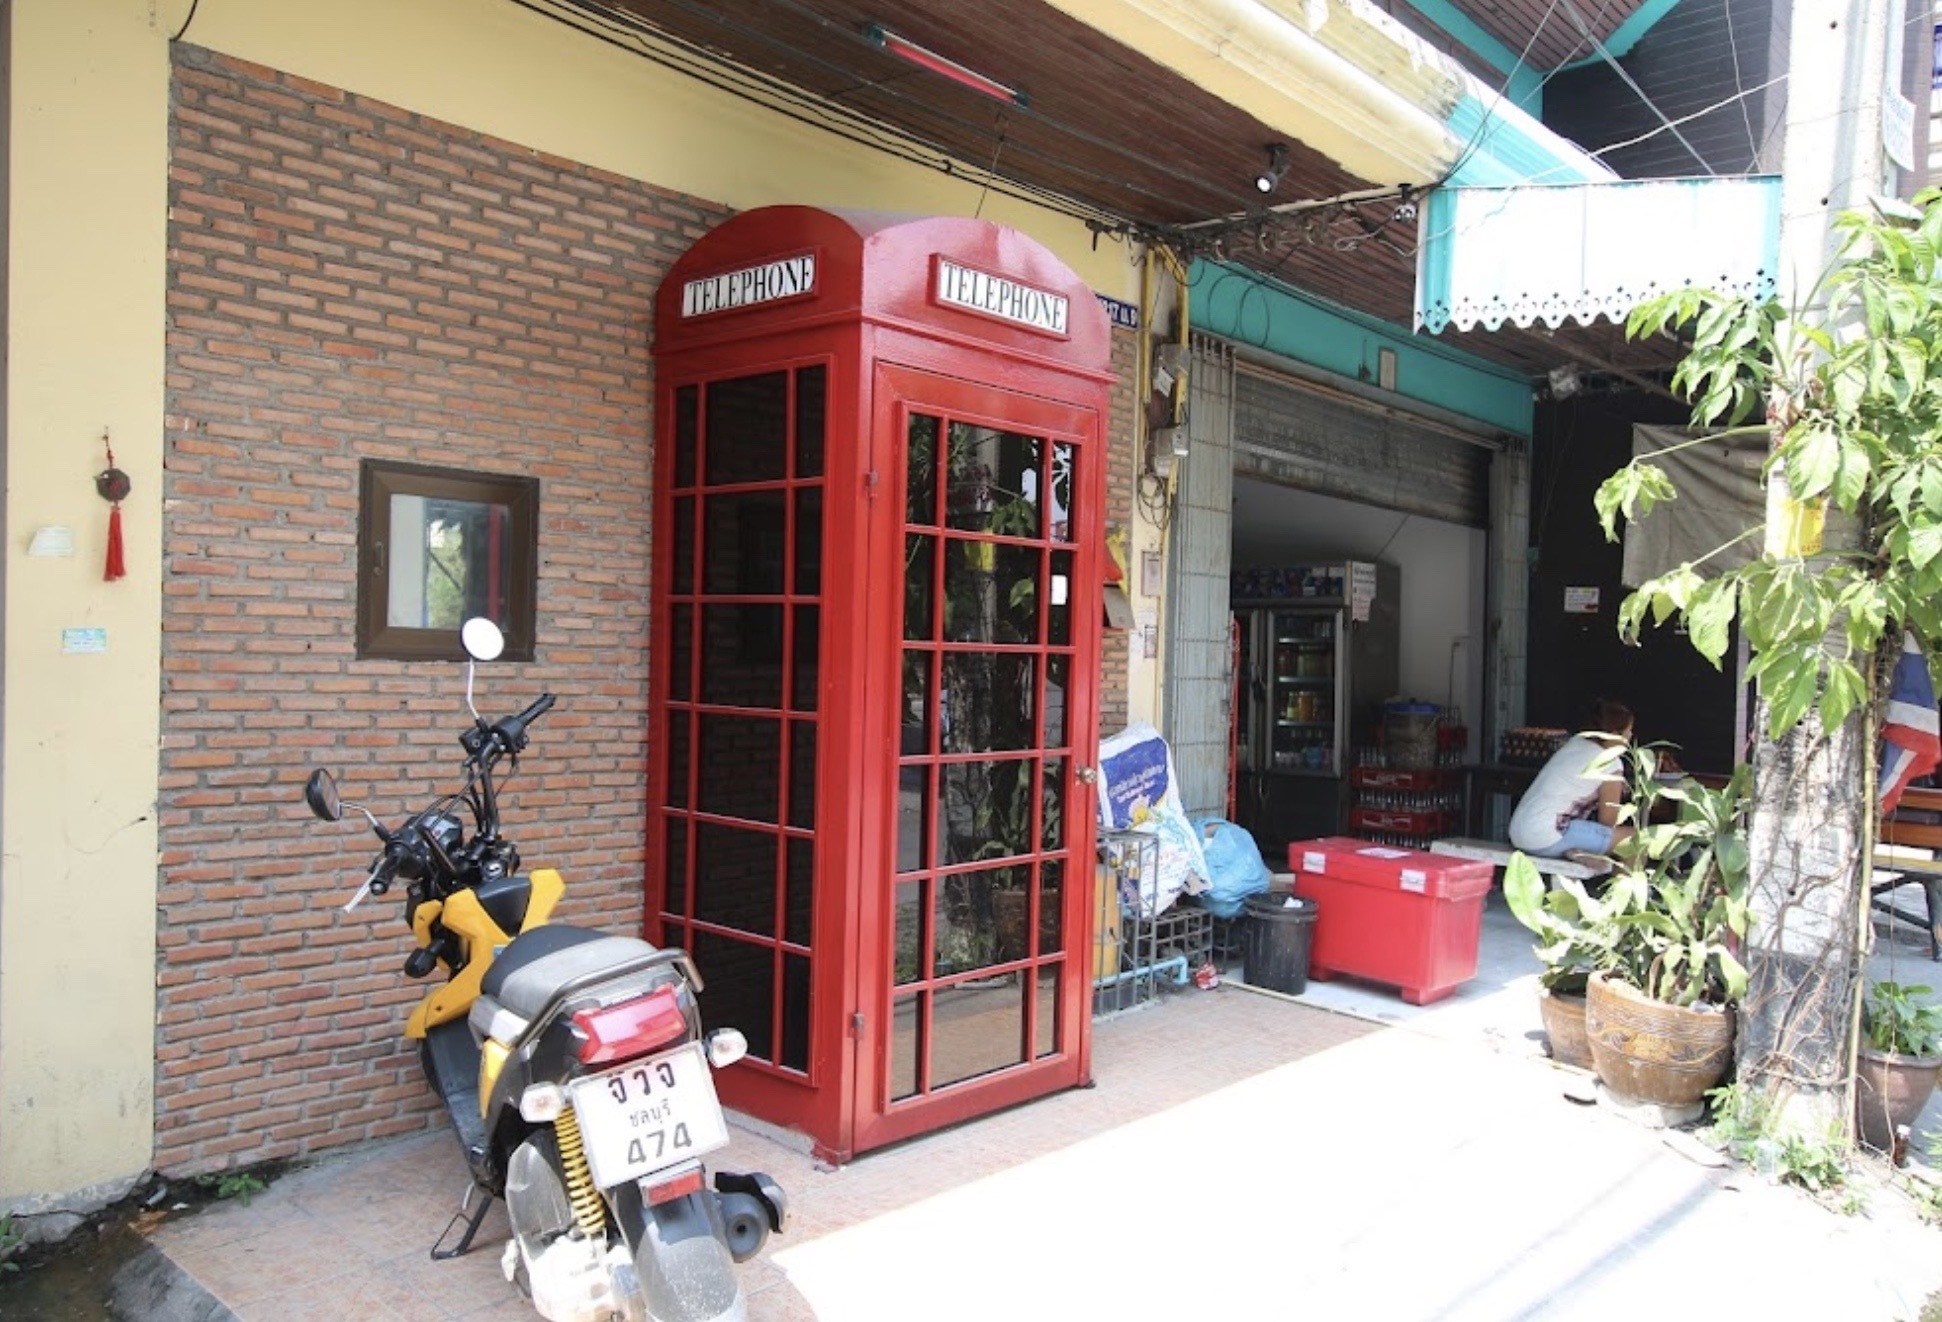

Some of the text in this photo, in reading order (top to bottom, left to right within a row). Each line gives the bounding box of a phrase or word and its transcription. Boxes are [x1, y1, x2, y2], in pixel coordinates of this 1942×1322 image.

[688, 256, 815, 315] TELEPHONE
[943, 262, 1065, 331] TELEPHONE
[629, 1099, 671, 1127] ชลบุรี
[627, 1121, 693, 1165] 474
